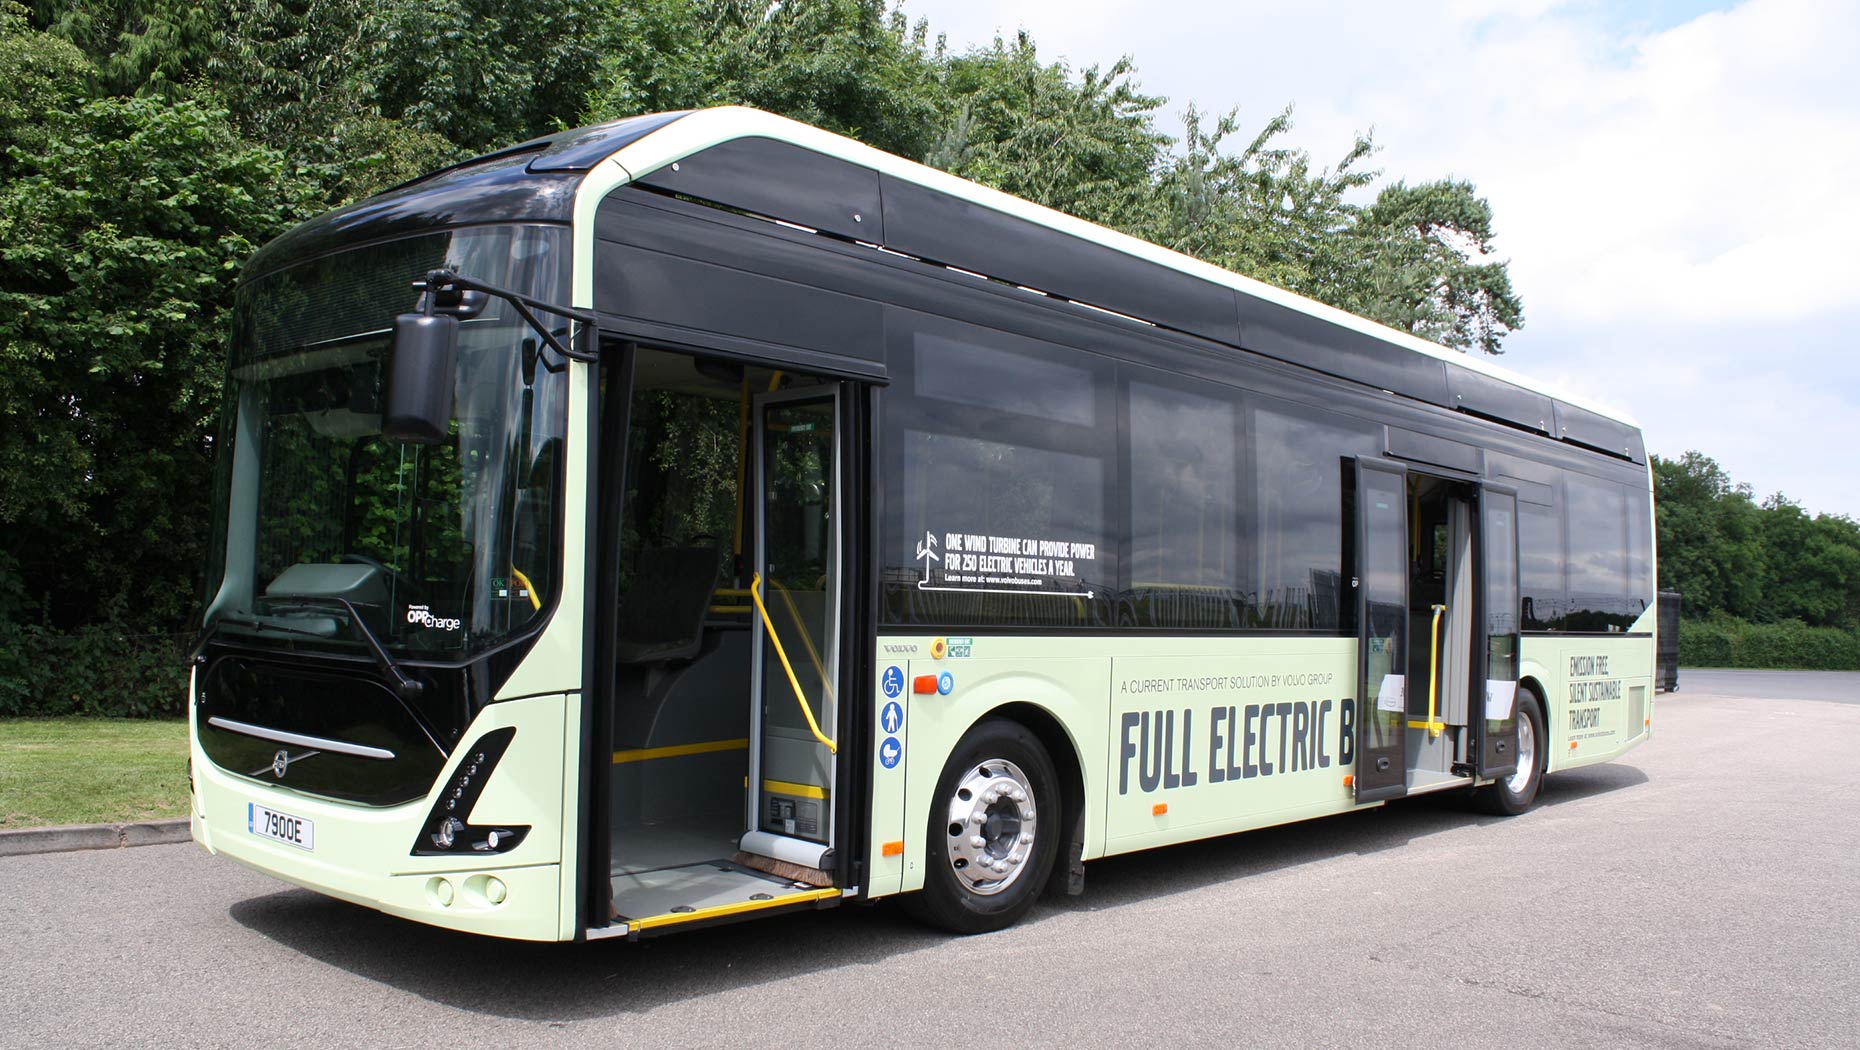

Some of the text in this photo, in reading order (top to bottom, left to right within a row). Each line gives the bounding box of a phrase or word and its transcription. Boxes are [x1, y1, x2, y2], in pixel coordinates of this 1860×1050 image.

[945, 533, 1095, 560] ONE WIND TURBINE CAN PROVIDE POWER
[945, 553, 1076, 577] FOR 250 ELECTRIC VEHICLES A YEAR.
[944, 573, 961, 582] Learn
[961, 575, 977, 583] more
[986, 576, 1043, 586] www.volvobuses.com
[883, 644, 918, 653] VOLVO
[1570, 656, 1595, 677] EMISSION
[1120, 672, 1333, 694] A CURRENT TRANSPORT SOLUTION BY VOLVO GROUP
[1569, 680, 1621, 704] SILENT SUSTAINABLE
[1569, 707, 1600, 730] TRANSPORT
[1119, 708, 1198, 796] FULL
[1208, 699, 1332, 784] ELECTRIC
[264, 811, 302, 843] 7900E
